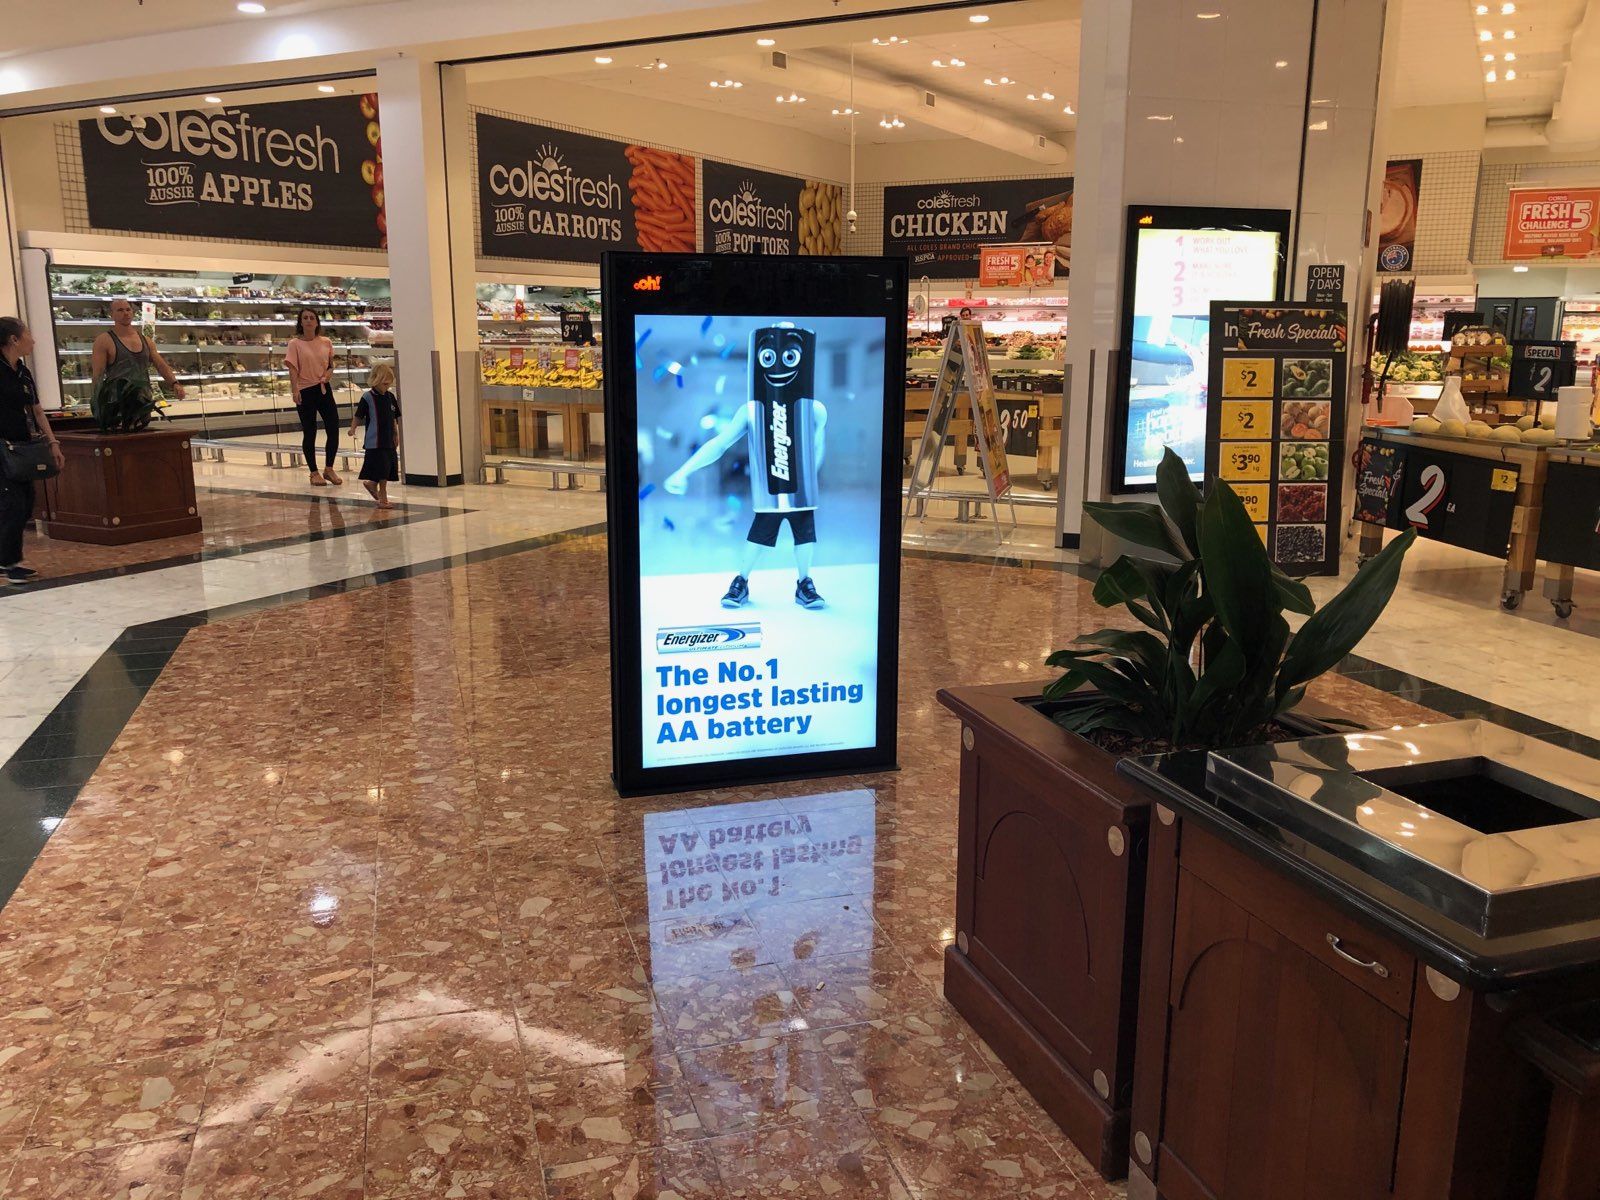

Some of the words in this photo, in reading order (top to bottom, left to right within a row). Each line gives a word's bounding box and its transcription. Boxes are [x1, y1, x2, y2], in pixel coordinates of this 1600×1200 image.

[146, 166, 194, 187] 100%
[149, 186, 194, 201] AUSSIE
[200, 172, 313, 211] APPLES
[494, 206, 525, 223] 100%
[1522, 203, 1571, 220] FRESH
[1571, 201, 1591, 228] 5
[496, 221, 525, 233] AUSSIE
[528, 209, 622, 242] CARROTS
[890, 210, 1008, 238] CHICKEN
[1520, 220, 1570, 230] CHALLENGE
[715, 231, 732, 245] 100%
[914, 252, 936, 262] RSPCA
[987, 256, 1010, 265] FRESH
[1173, 261, 1185, 282] 2
[1312, 267, 1340, 278] OPEN
[1310, 279, 1315, 290] 7
[1317, 279, 1341, 290] DAYS
[1248, 322, 1285, 339] Fresh
[1287, 323, 1338, 342] Specials
[1527, 348, 1559, 358] SPECIAL
[1241, 370, 1257, 387] $2
[1238, 411, 1254, 429] $2
[770, 401, 793, 481] Energizer
[1364, 471, 1385, 485] Fresh
[1359, 482, 1389, 499] Specials
[663, 631, 720, 647] Energizer
[656, 665, 709, 687] The
[718, 658, 778, 683] No.1
[657, 688, 763, 715] longest
[771, 682, 864, 707] lasting
[656, 720, 699, 744] AA
[708, 715, 812, 740] battery
